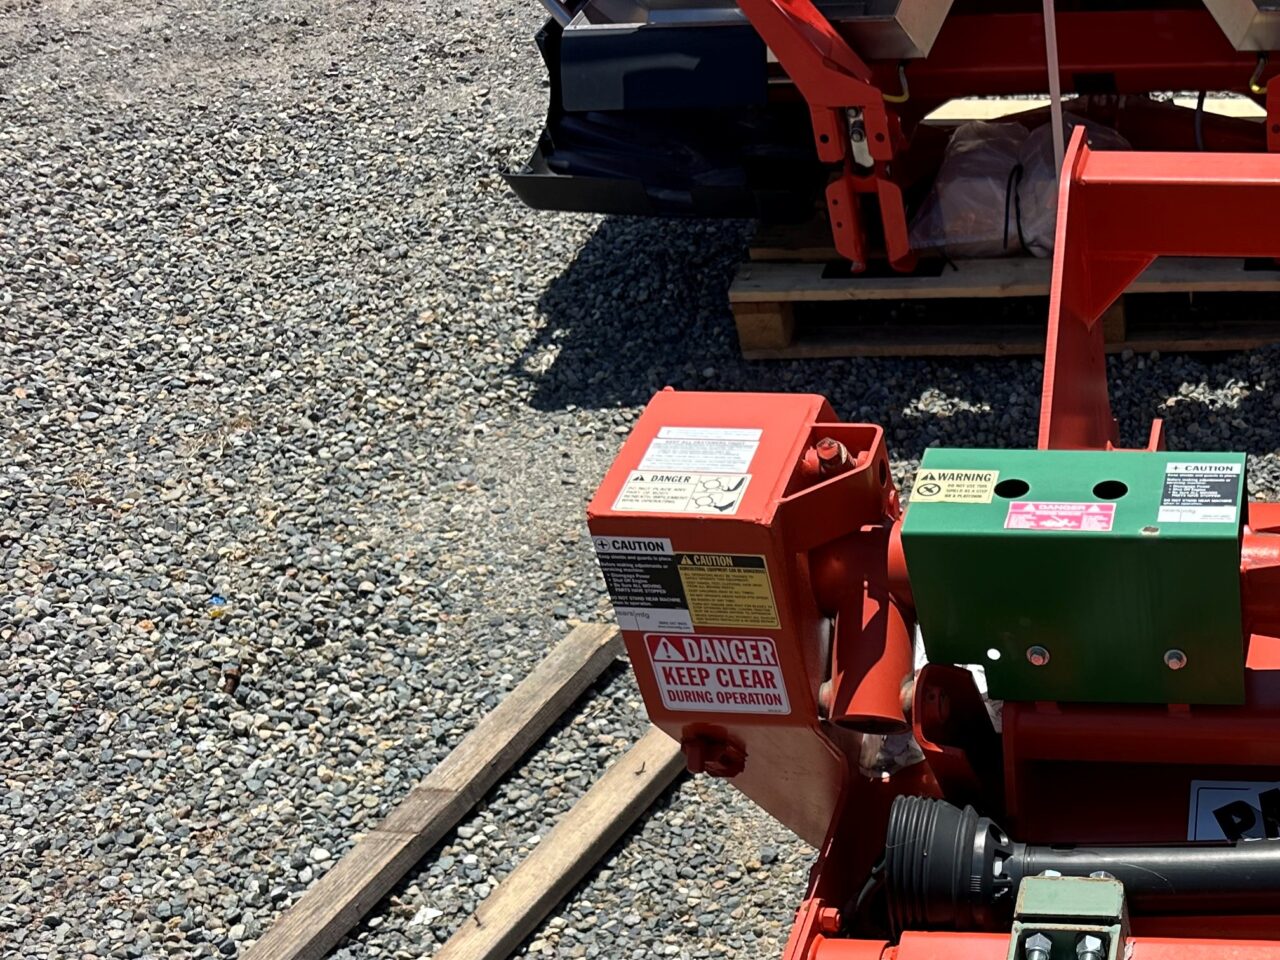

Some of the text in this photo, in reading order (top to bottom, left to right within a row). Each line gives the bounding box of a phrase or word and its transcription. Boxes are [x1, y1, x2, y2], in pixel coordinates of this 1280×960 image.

[651, 475, 692, 483] DANGER
[938, 472, 992, 482] WARNING
[612, 540, 665, 552] CAUTION
[693, 555, 733, 566] CAUTION
[682, 638, 776, 664] DANGER
[662, 666, 778, 689] KEEP CLEAR
[667, 690, 783, 705] DURING OPERATION
